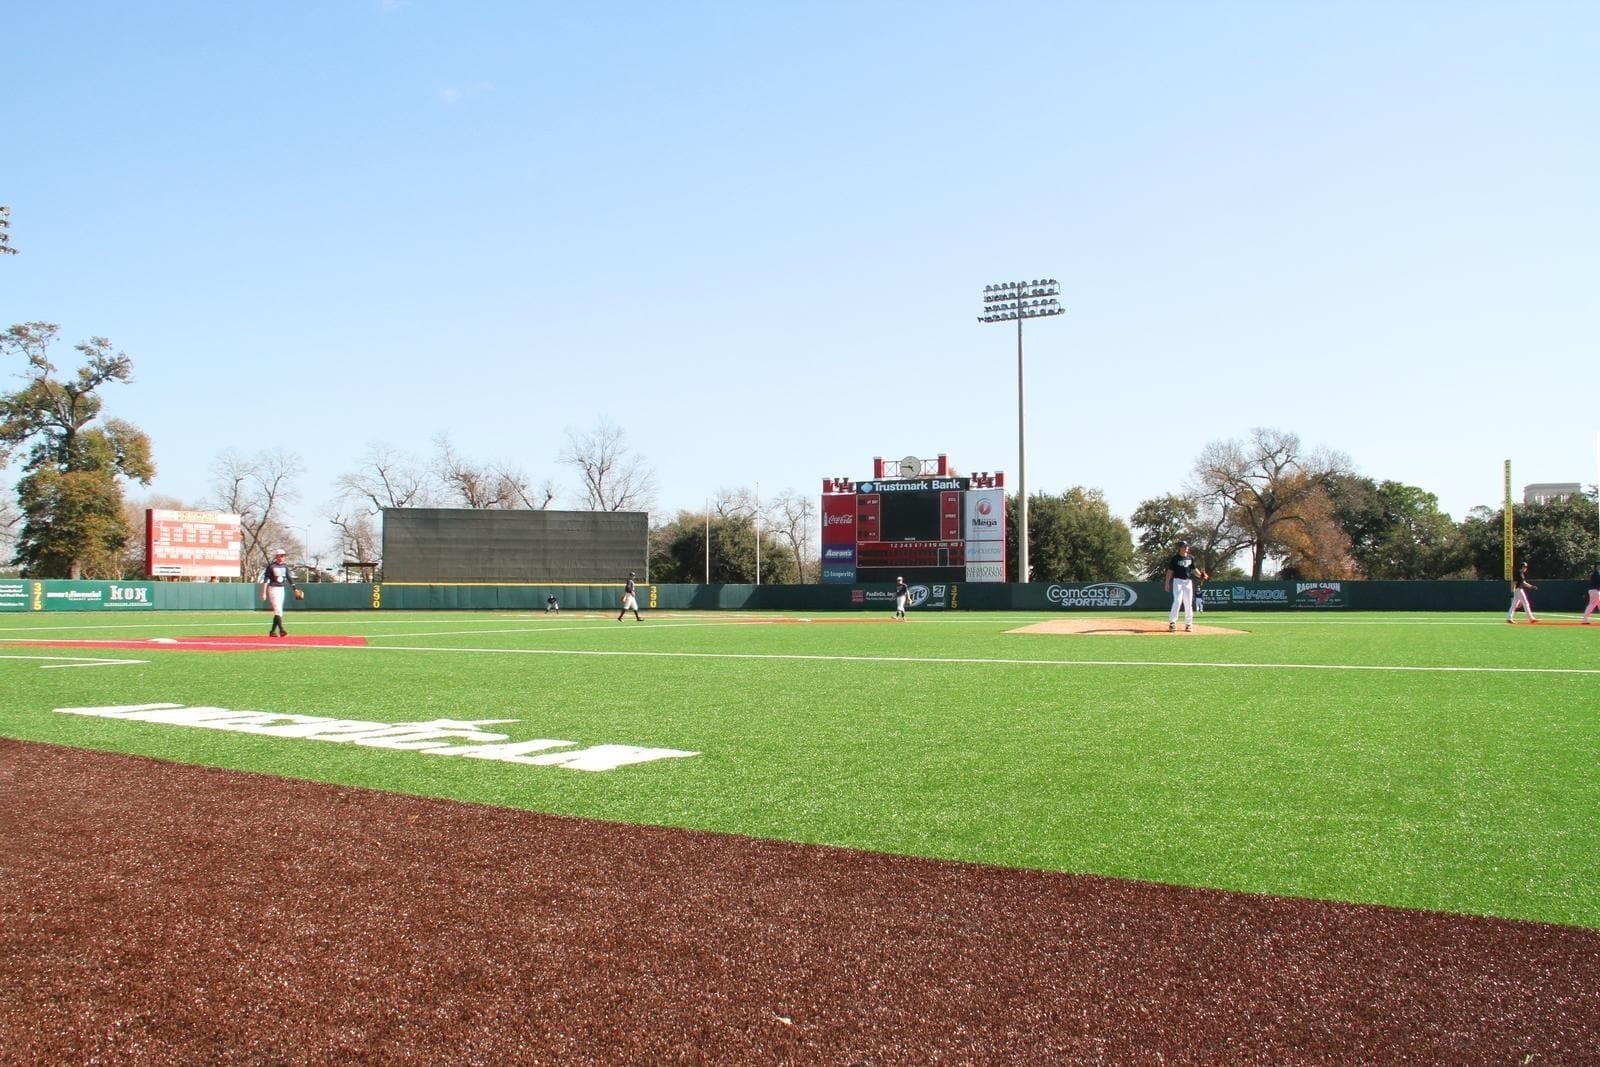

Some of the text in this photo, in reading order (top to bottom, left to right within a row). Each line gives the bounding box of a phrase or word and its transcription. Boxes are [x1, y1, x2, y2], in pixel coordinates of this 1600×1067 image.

[873, 480, 960, 492] Trustmark Bank
[972, 519, 997, 527] Mega
[1200, 589, 1231, 597] ZTEC
[1062, 599, 1125, 607] SPORTSNET
